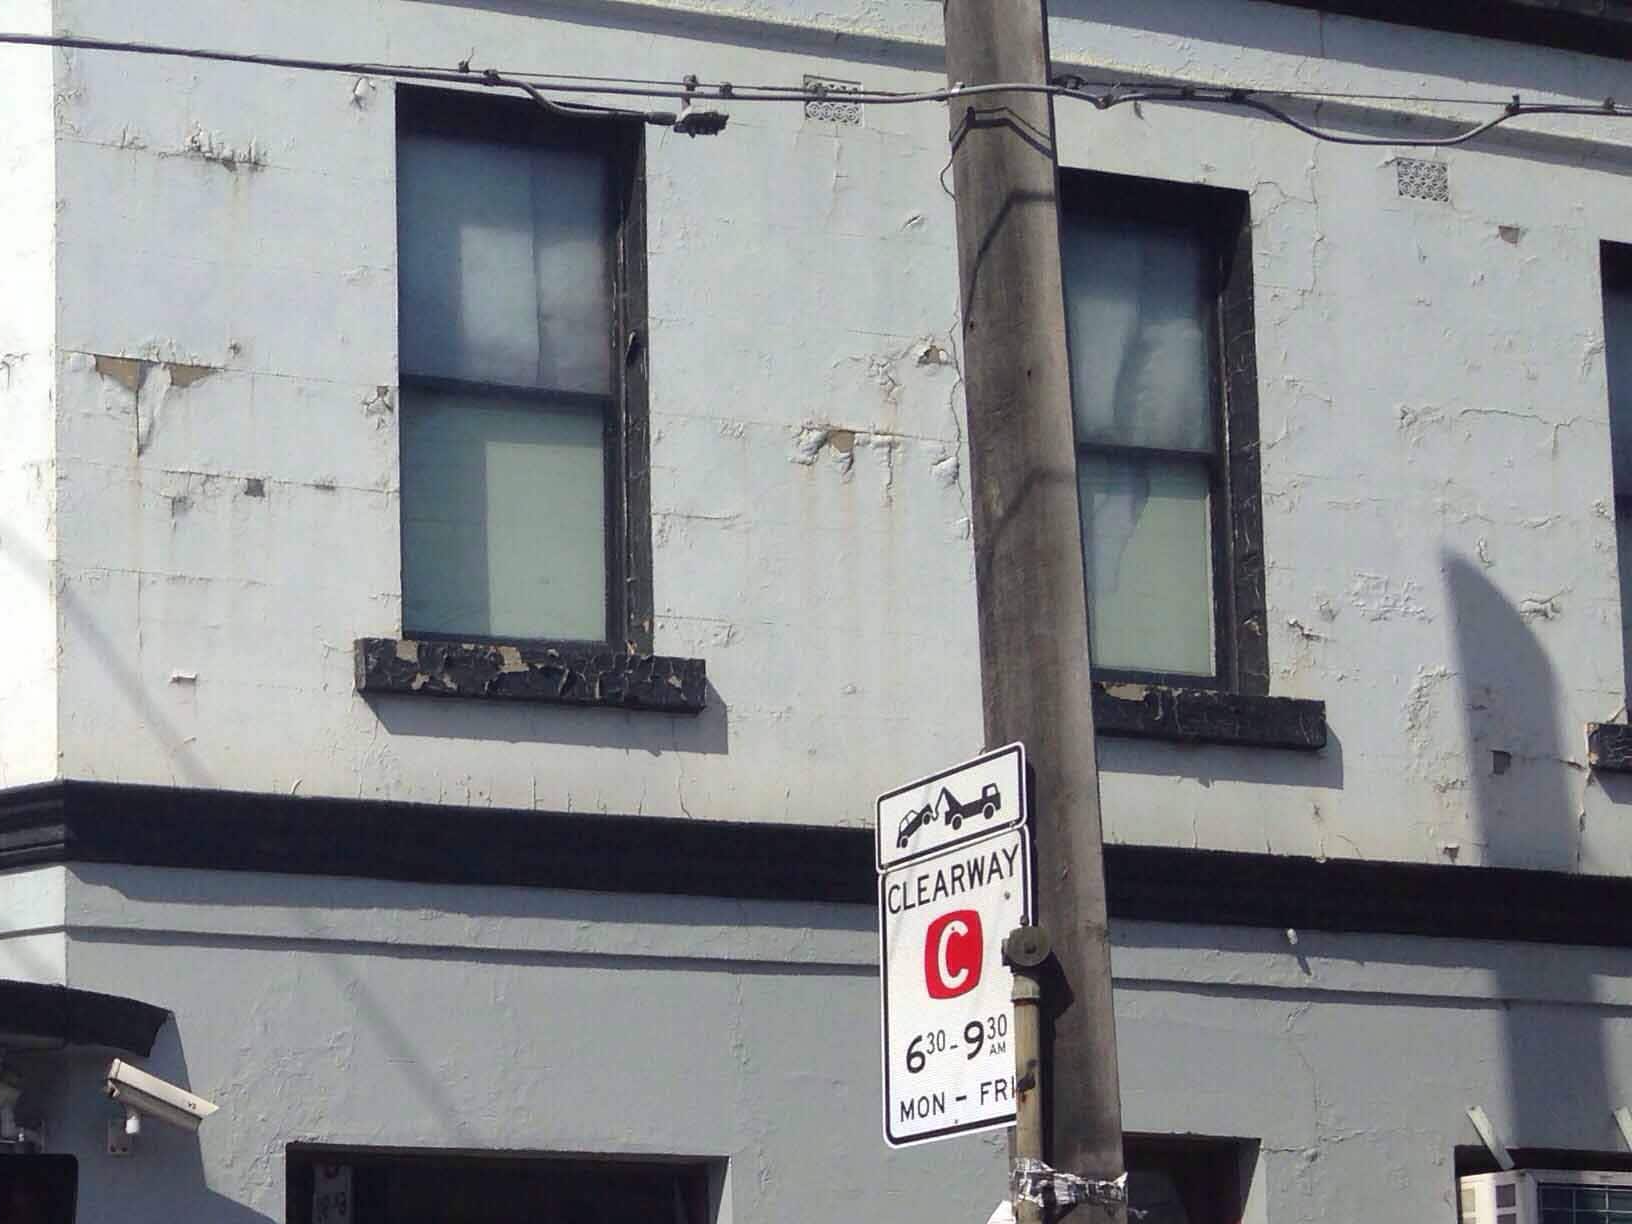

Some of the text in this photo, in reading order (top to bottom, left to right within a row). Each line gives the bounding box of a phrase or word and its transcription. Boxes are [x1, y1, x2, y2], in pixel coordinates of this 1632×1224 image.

[887, 843, 1019, 915] CLEARWAY
[937, 919, 969, 990] C
[899, 1091, 946, 1123] MON
[980, 1074, 1016, 1106] FRI
